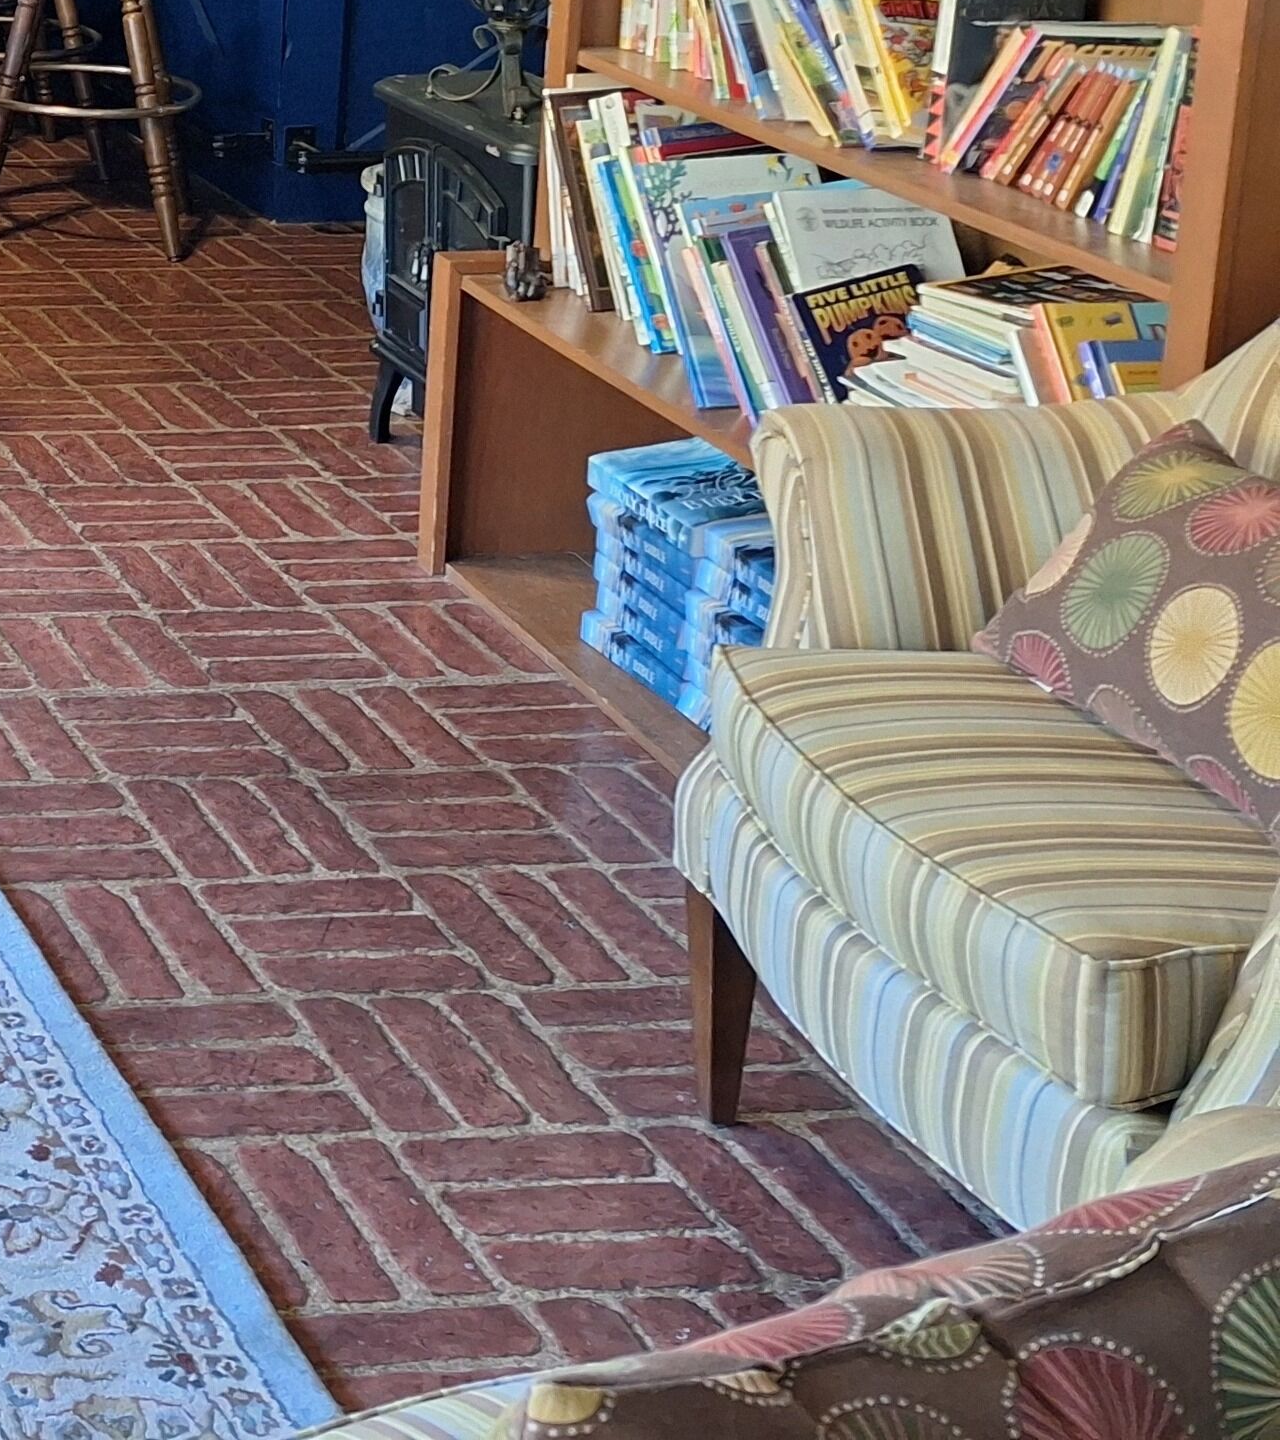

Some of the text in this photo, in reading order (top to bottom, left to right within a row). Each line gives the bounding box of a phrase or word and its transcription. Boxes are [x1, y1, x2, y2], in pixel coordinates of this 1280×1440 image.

[822, 216, 939, 229] WILDLIFE ACTIVITY BOOK
[804, 271, 911, 308] FIVE LITTLE
[811, 283, 920, 345] PUMPKINS
